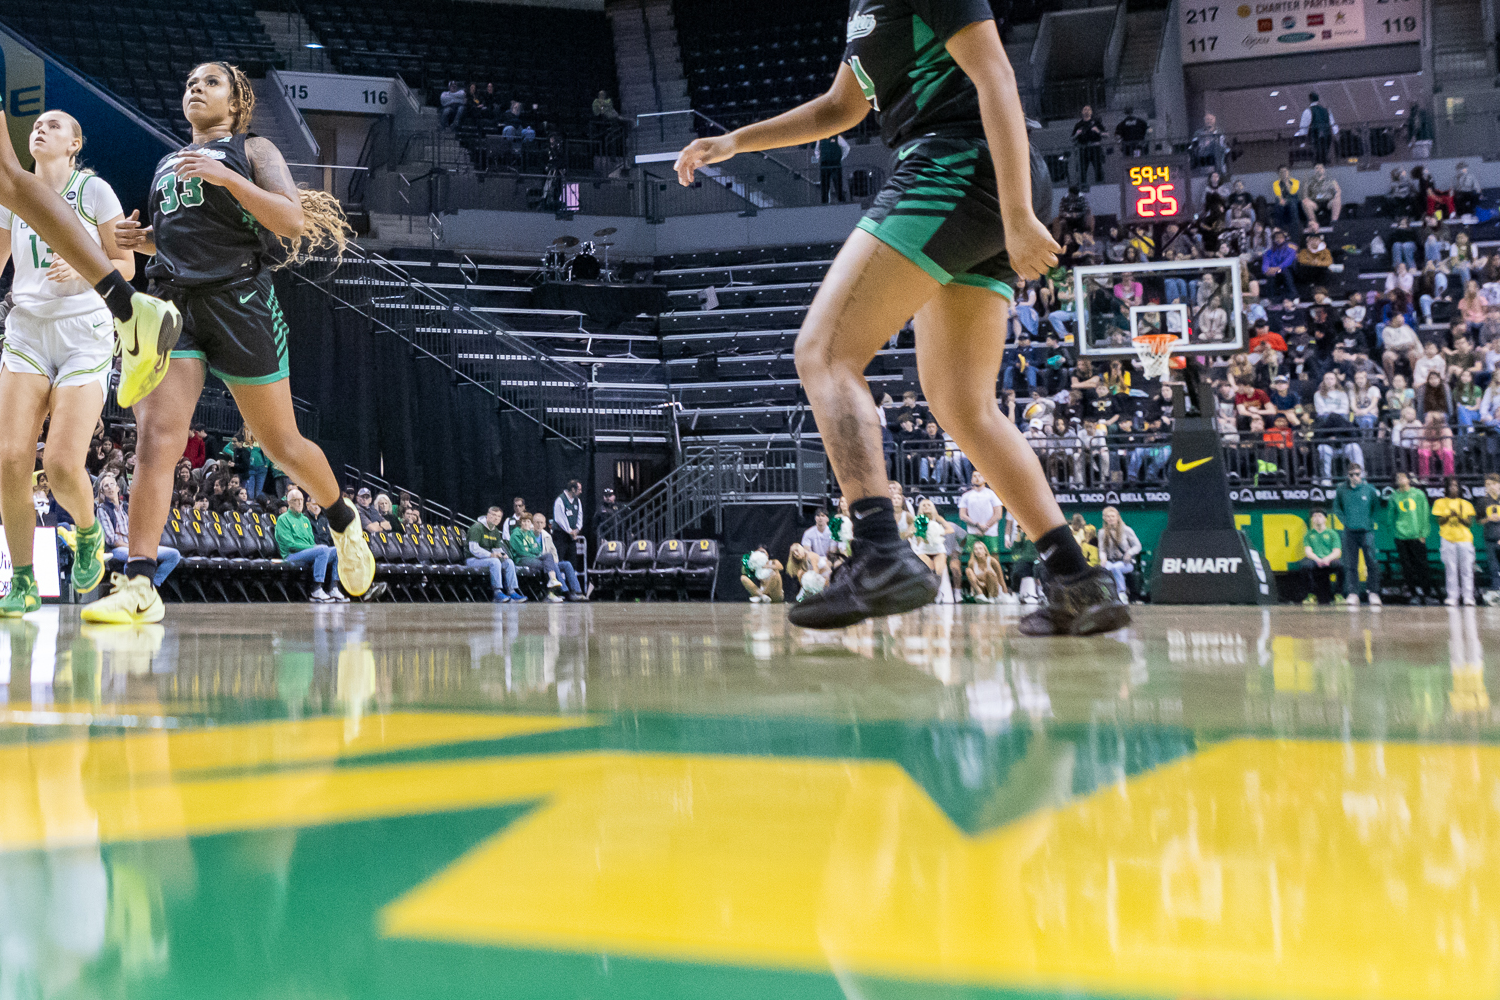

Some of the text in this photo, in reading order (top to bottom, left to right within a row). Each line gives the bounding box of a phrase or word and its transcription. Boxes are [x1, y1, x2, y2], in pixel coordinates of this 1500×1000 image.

[1186, 6, 1219, 24] 217
[1256, 0, 1300, 15] CHARTER
[1382, 16, 1417, 34] 119
[1188, 36, 1219, 53] 117
[362, 90, 388, 105] 116
[1129, 166, 1170, 186] 59.4
[156, 172, 204, 215] 33
[1136, 183, 1179, 217] 25
[1055, 491, 1170, 503] BELL TACO BELL TACO
[1255, 489, 1309, 500] BELL TACO
[1426, 487, 1446, 498] TAC
